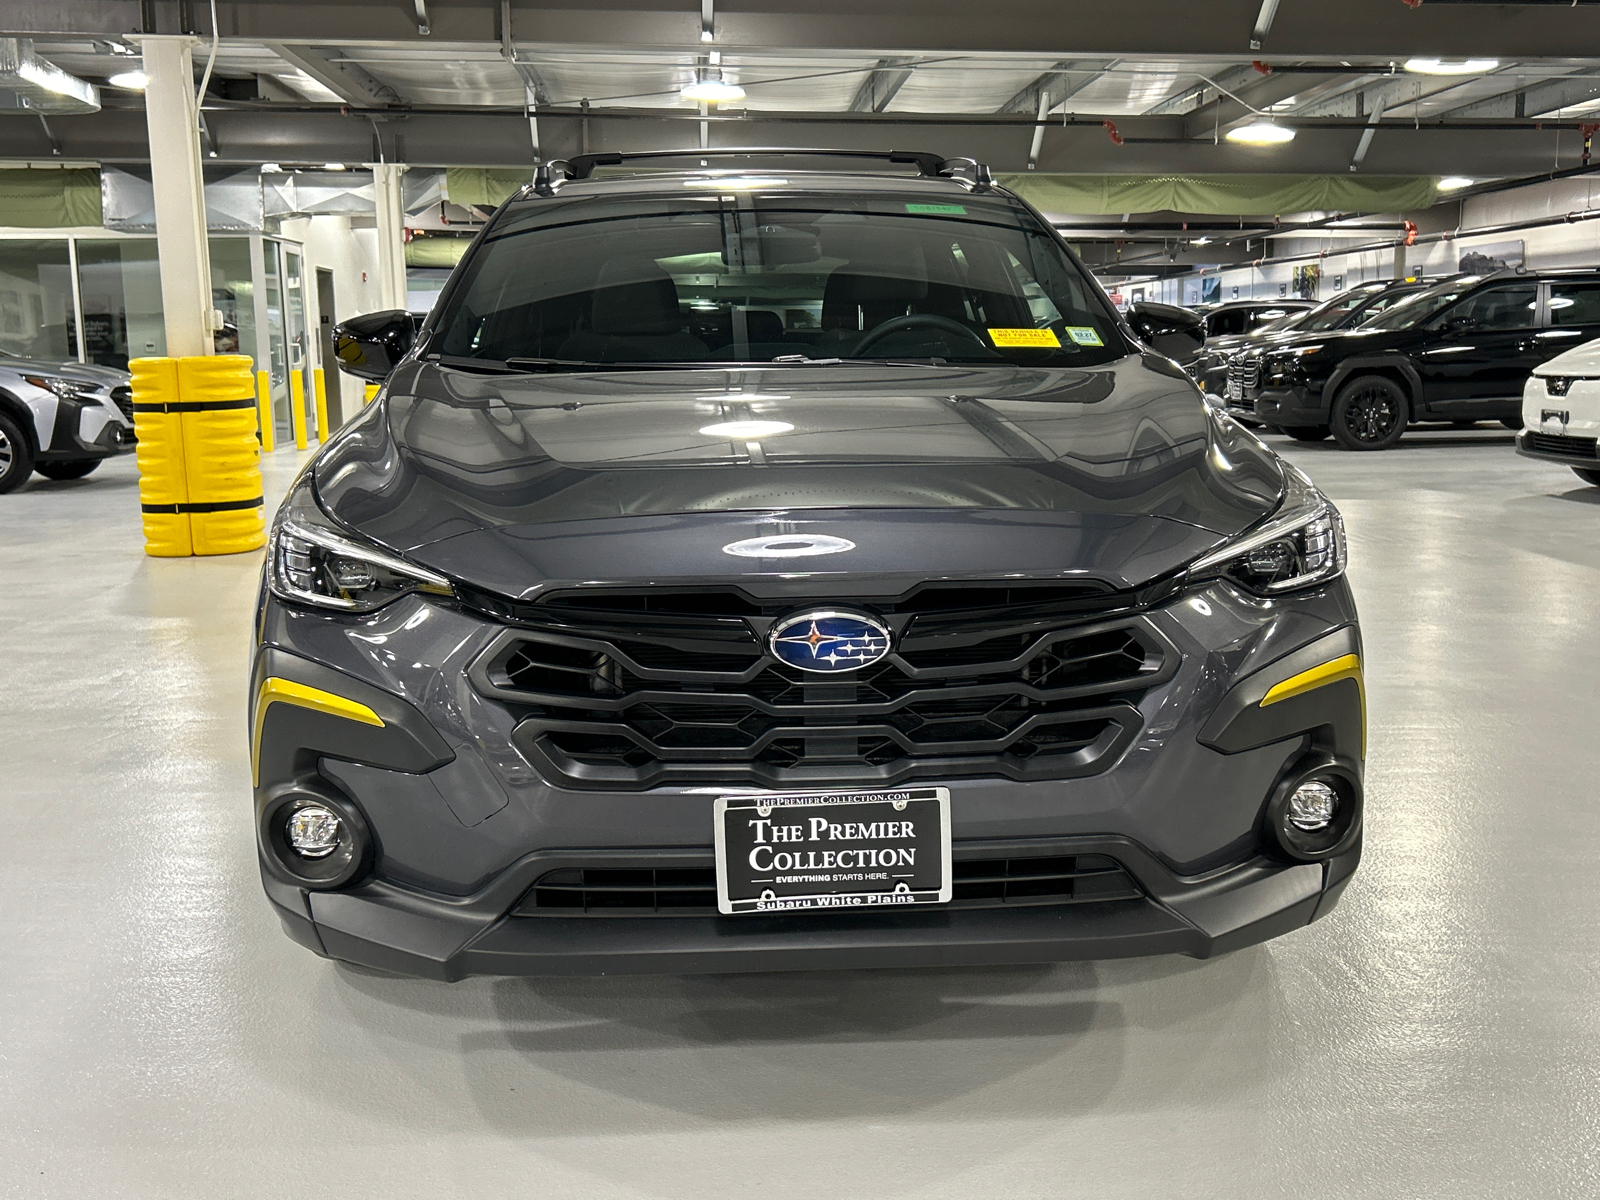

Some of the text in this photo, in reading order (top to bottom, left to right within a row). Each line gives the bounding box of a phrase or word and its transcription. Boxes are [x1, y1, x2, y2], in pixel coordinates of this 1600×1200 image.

[749, 817, 916, 843] THE PREMIER
[749, 846, 916, 871] COLLECTION
[775, 872, 889, 884] EVERYTHING STARTS HERE.
[756, 893, 915, 911] Subaru White Plains
